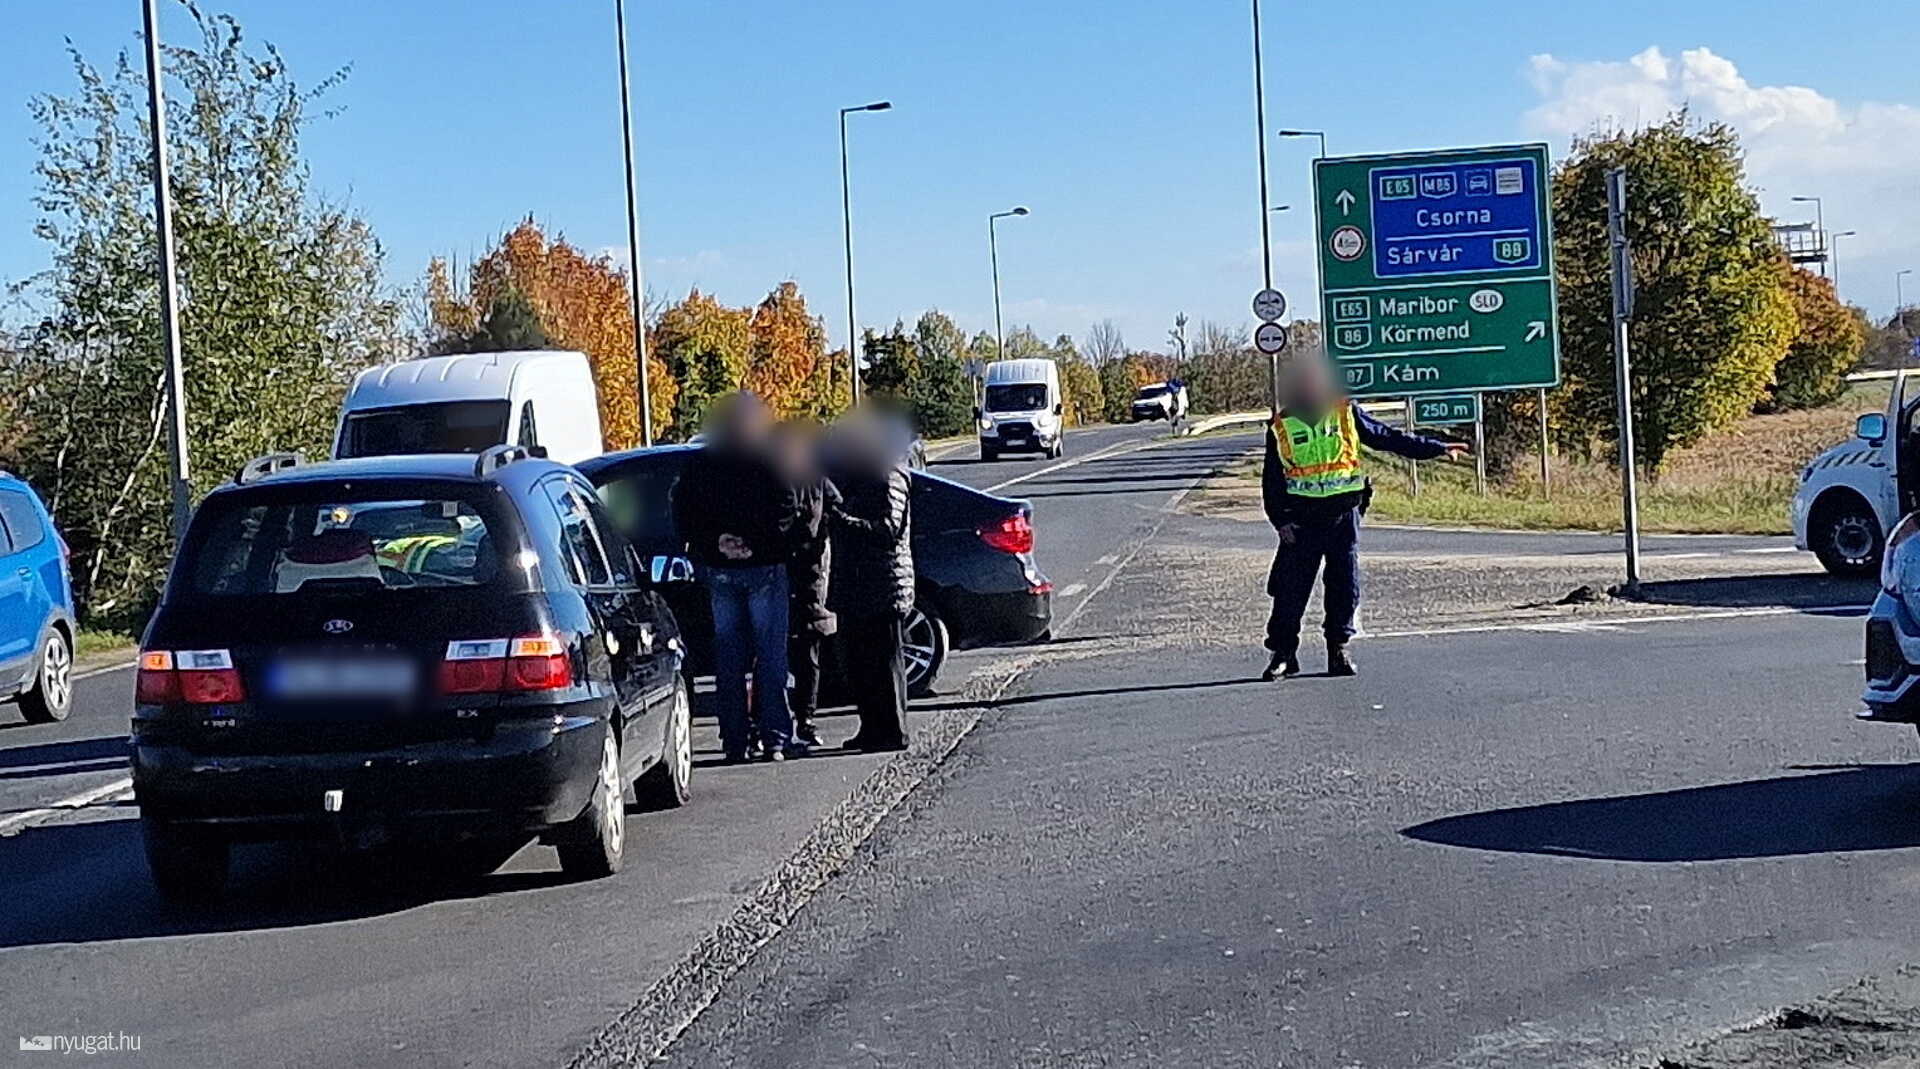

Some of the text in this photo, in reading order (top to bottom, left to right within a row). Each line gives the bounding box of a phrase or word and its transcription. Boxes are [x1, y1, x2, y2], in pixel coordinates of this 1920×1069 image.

[1416, 209, 1491, 227] Csorna
[1387, 244, 1463, 265] Sárvár
[1379, 296, 1459, 317] Maribor
[1475, 295, 1499, 308] SLO
[1380, 320, 1470, 344] Körmend
[1383, 364, 1440, 383] Kám
[1421, 402, 1468, 417] 250 m
